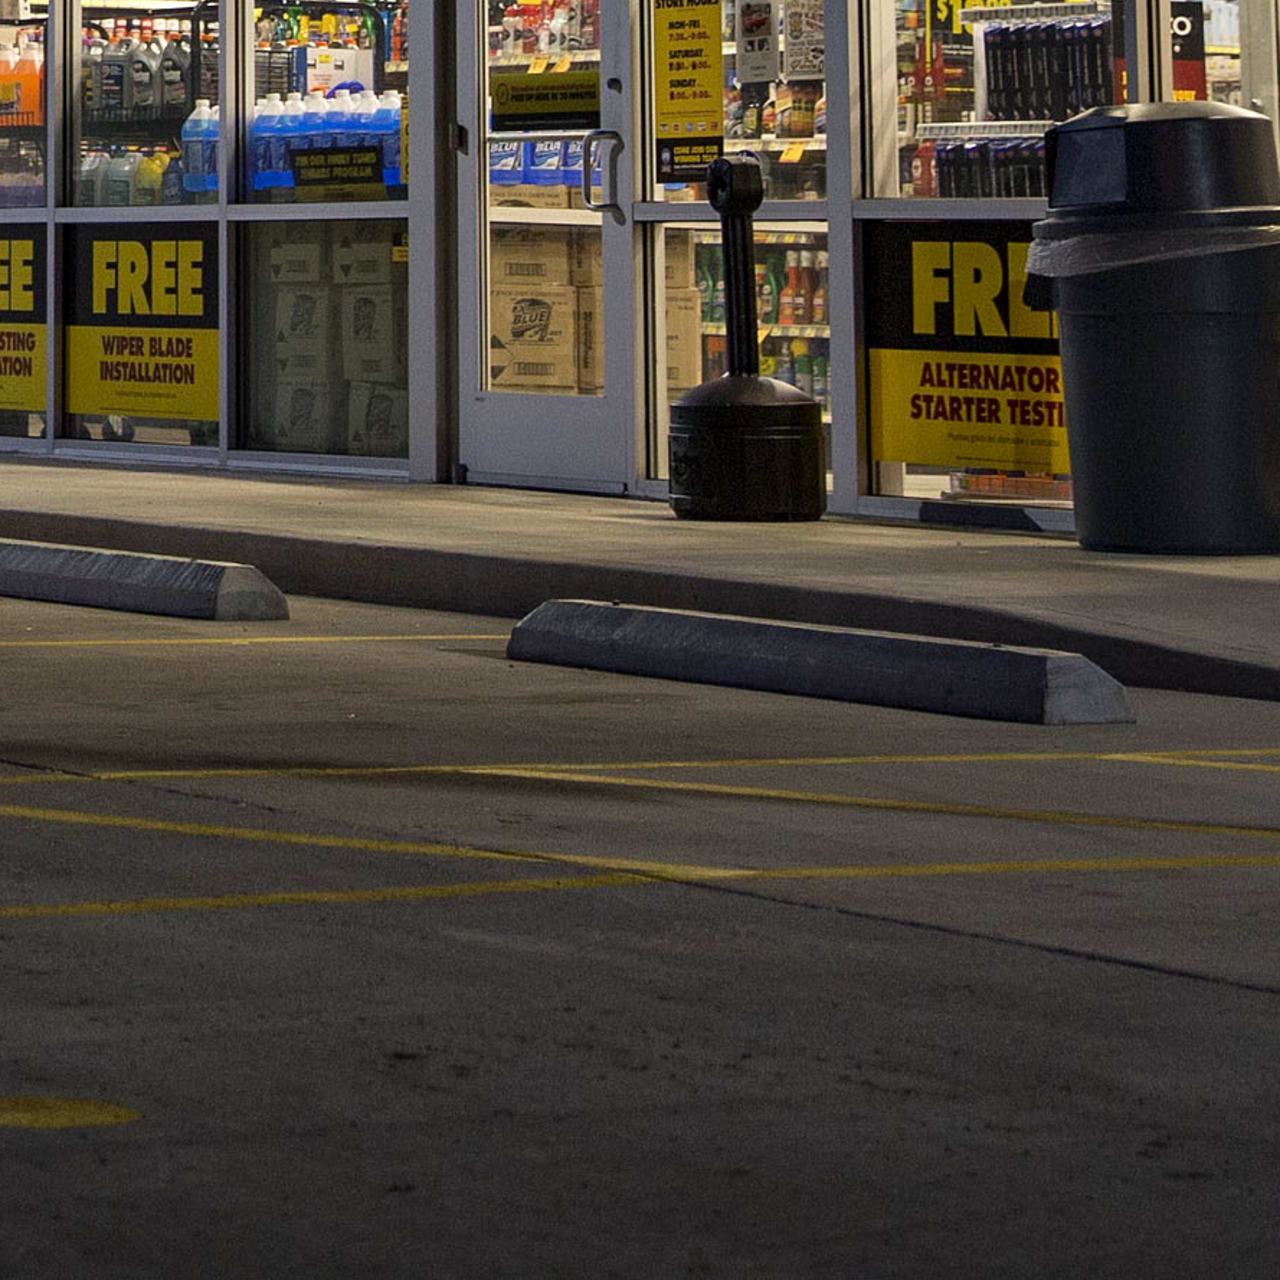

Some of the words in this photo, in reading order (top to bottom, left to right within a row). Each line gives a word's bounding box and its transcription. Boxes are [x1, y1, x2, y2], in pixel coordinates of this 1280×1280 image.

[668, 48, 703, 59] SATURDAY
[669, 78, 696, 88] SUNDAY
[92, 241, 204, 317] FREE
[513, 310, 546, 325] BLUE
[101, 335, 145, 357] WIPER
[149, 337, 193, 358] BLADE
[100, 360, 195, 385] INSTALLATION
[920, 362, 1060, 393] ALTERNATOR
[910, 394, 1001, 424] STARTER
[1007, 399, 1065, 429] TESTI
